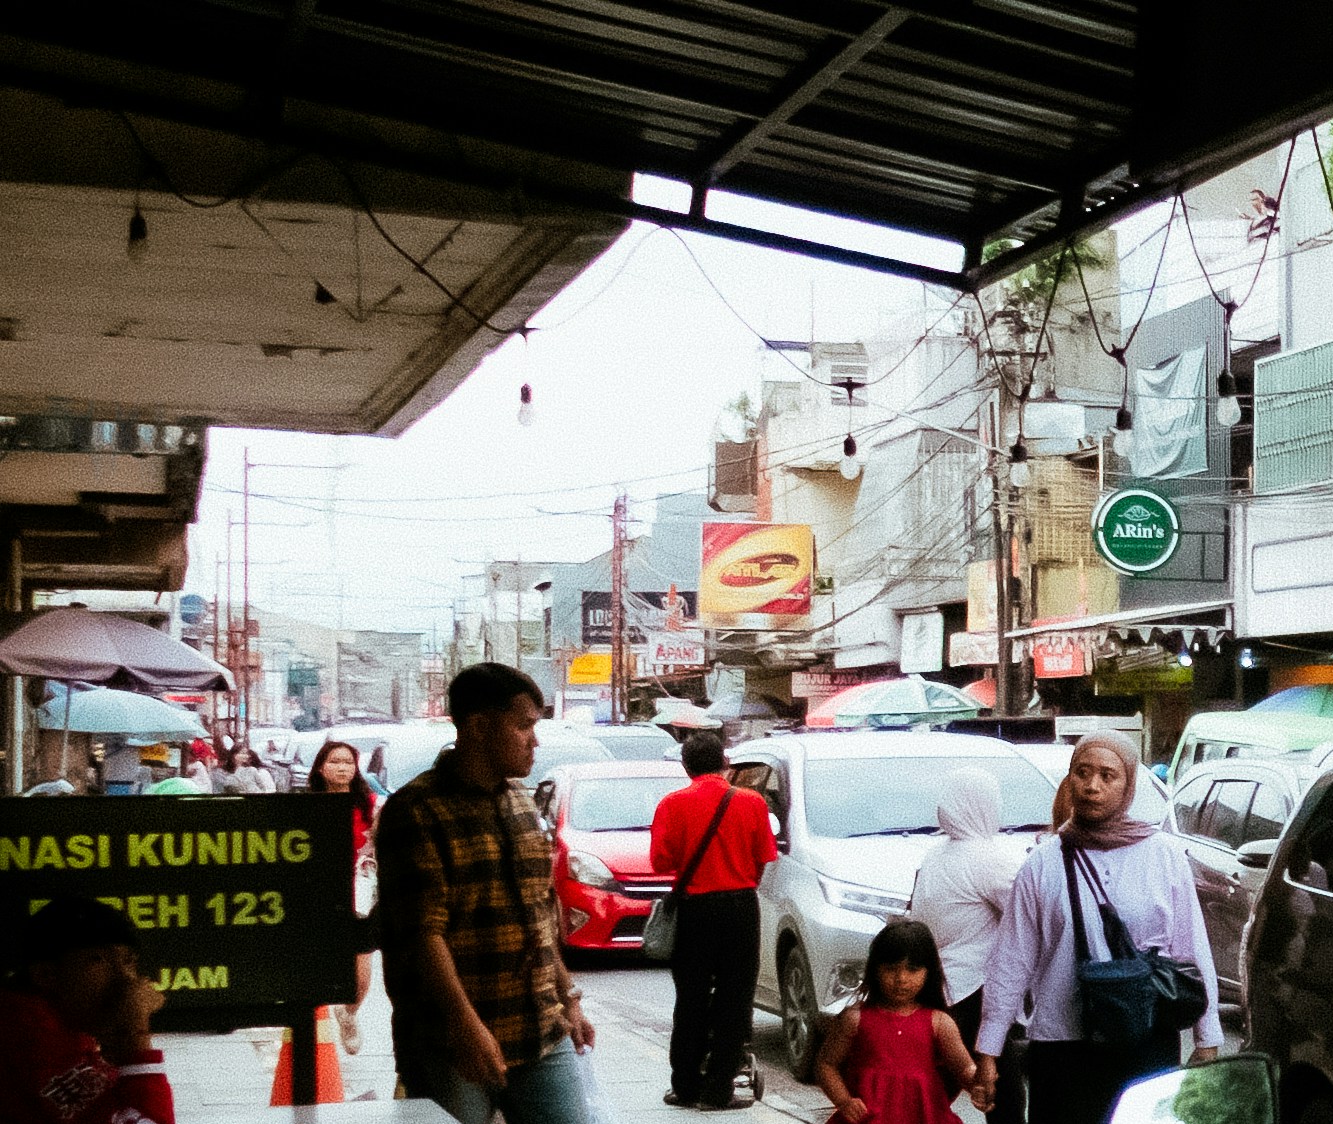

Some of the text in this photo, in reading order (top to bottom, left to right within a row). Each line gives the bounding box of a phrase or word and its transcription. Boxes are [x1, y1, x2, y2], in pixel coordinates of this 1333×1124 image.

[1112, 522, 1165, 539] ARin's
[0, 830, 311, 870] NASI KUNING
[206, 891, 285, 925] 123
[151, 966, 229, 991] JAM
